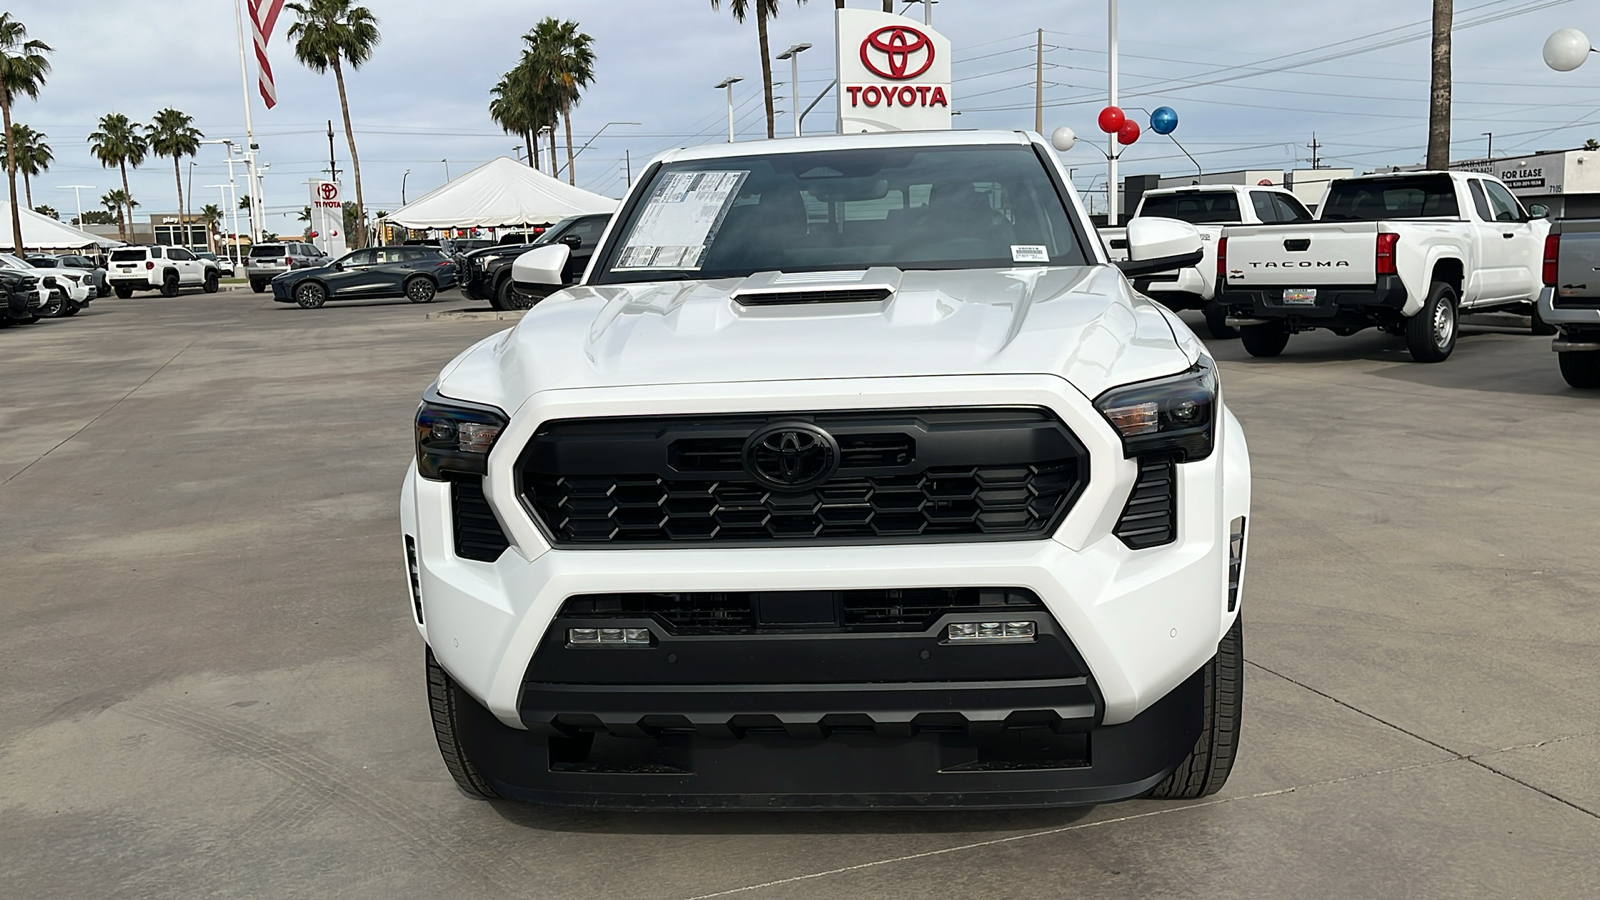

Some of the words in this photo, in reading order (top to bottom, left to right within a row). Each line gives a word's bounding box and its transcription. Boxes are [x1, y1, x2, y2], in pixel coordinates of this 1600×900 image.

[846, 85, 948, 107] TOYOTA
[1501, 170, 1517, 179] FOR
[1519, 168, 1542, 178] LEASE
[1549, 185, 1562, 193] 7105
[162, 216, 179, 224] play
